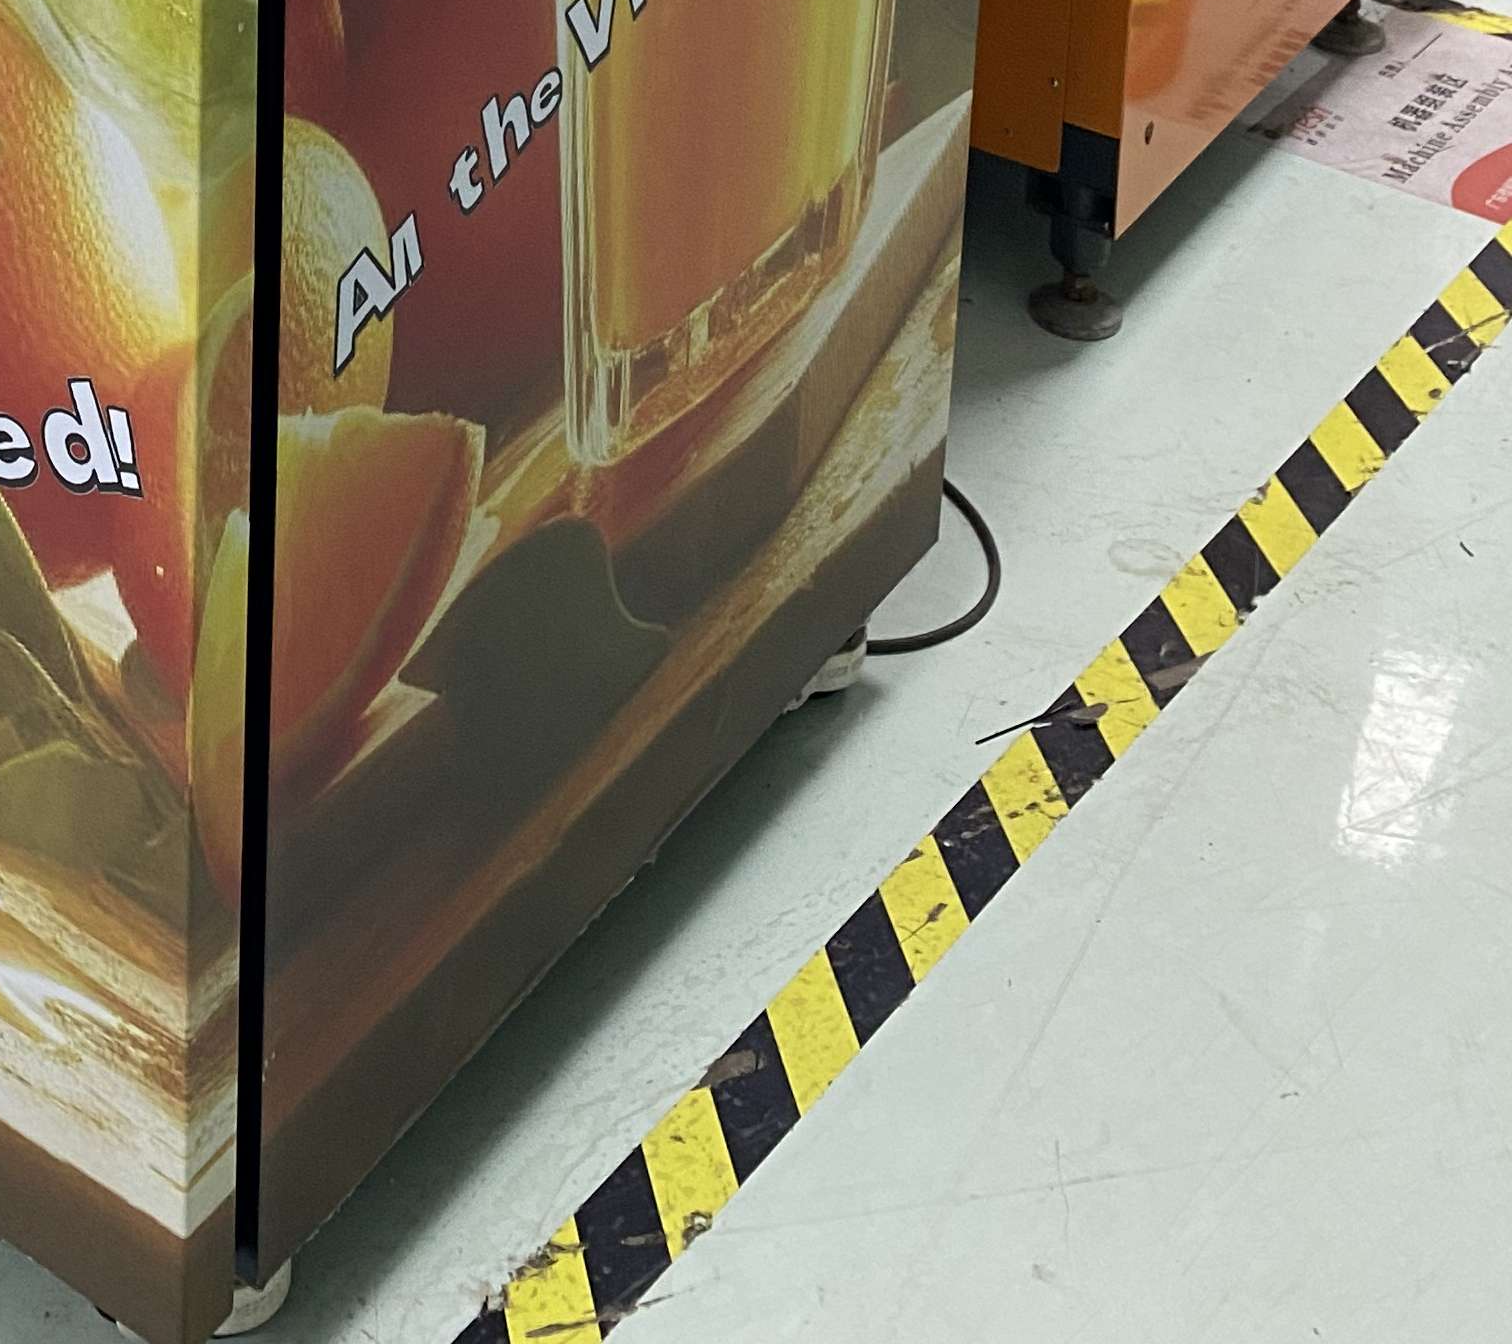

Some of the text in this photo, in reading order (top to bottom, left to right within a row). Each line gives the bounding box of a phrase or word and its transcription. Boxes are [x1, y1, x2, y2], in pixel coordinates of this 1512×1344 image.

[448, 67, 562, 216] the
[1382, 129, 1453, 184] Machine
[1440, 77, 1512, 133] Assembly
